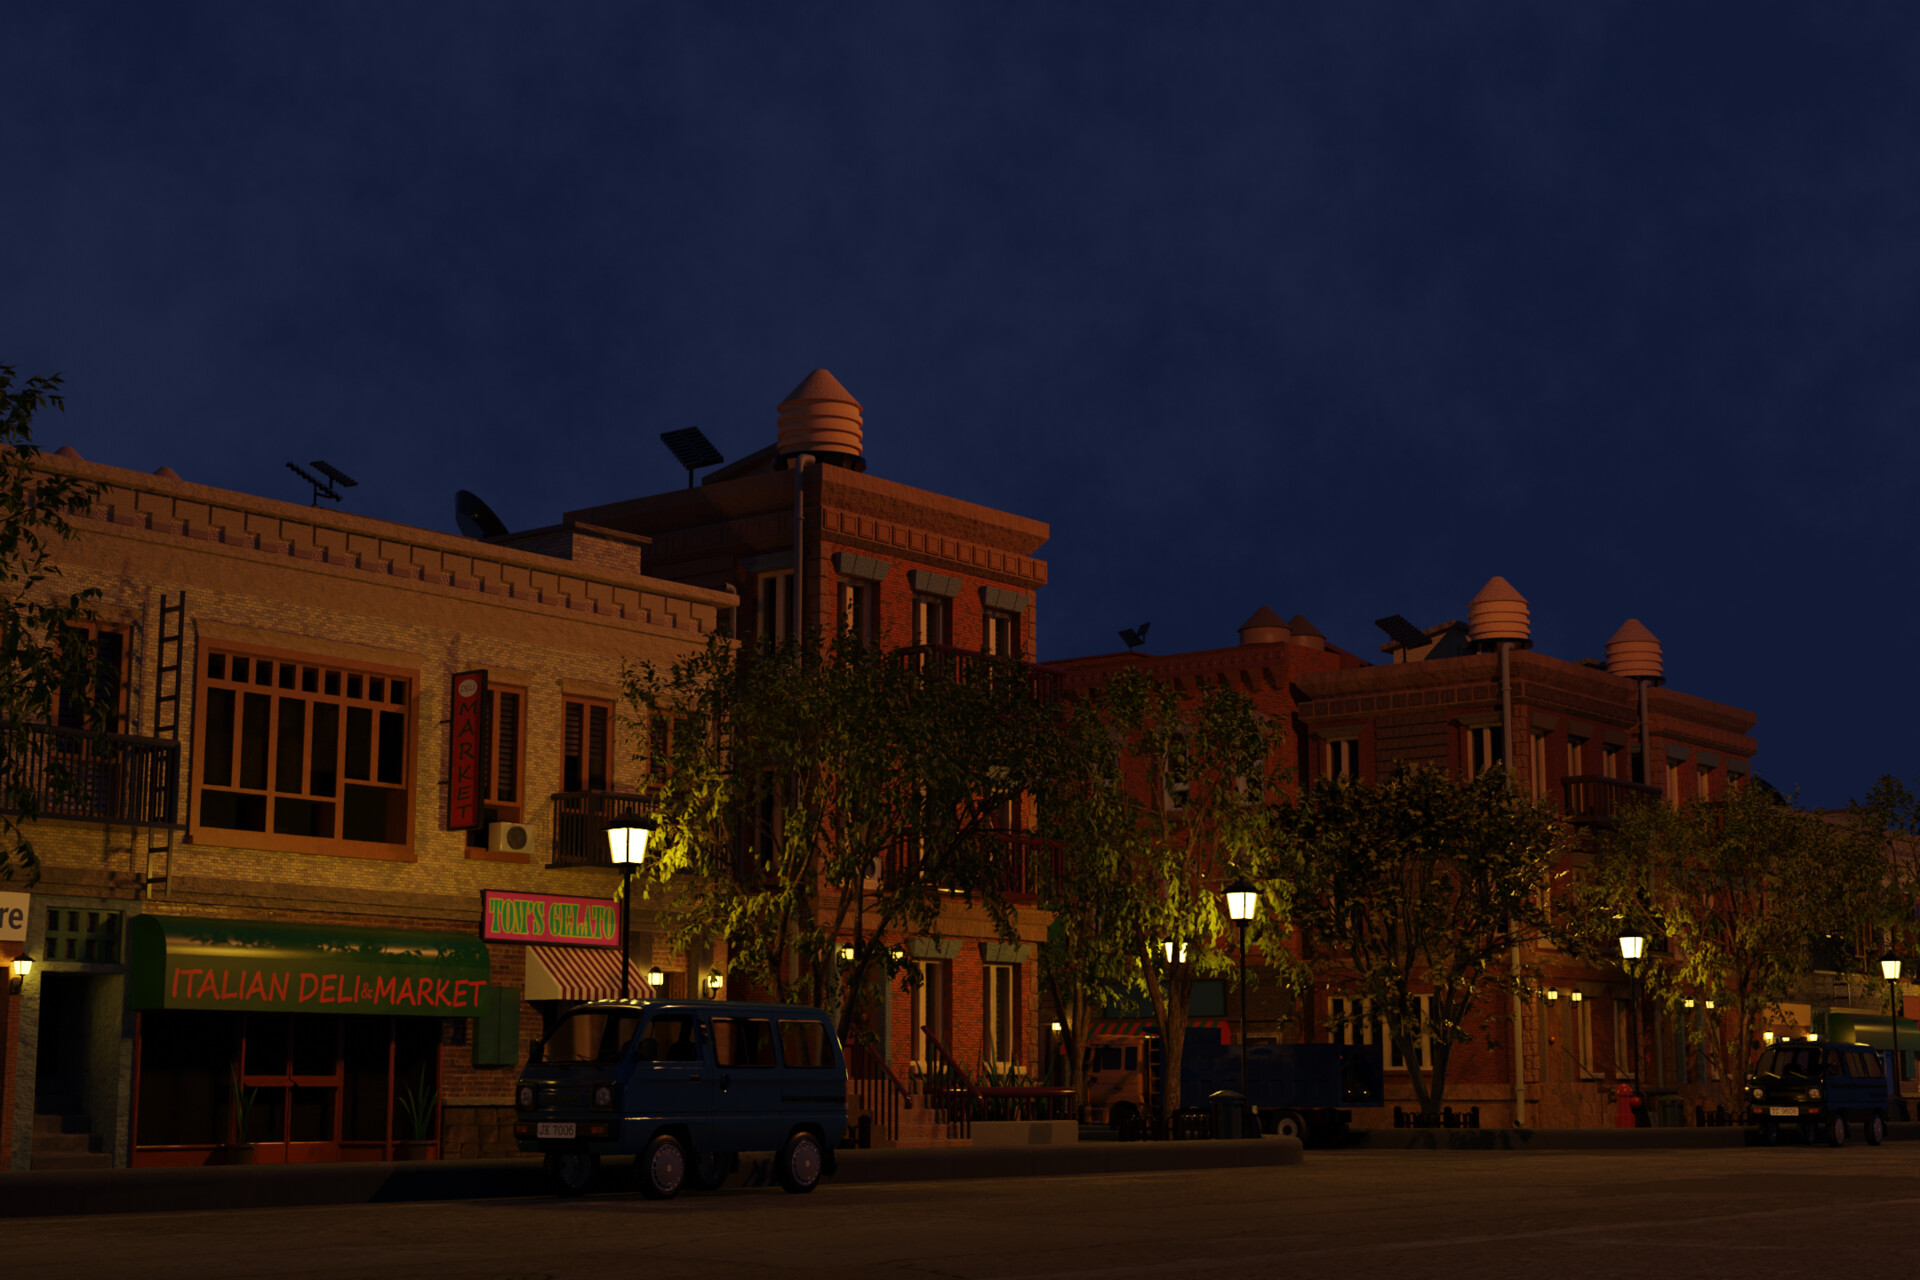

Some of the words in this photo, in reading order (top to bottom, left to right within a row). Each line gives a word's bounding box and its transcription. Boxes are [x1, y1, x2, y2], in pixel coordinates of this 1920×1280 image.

[459, 684, 476, 693] DELI
[456, 701, 477, 818] MARKET
[489, 897, 545, 935] TOM'S
[549, 902, 616, 940] GELATO
[171, 967, 290, 1002] ITALIAN
